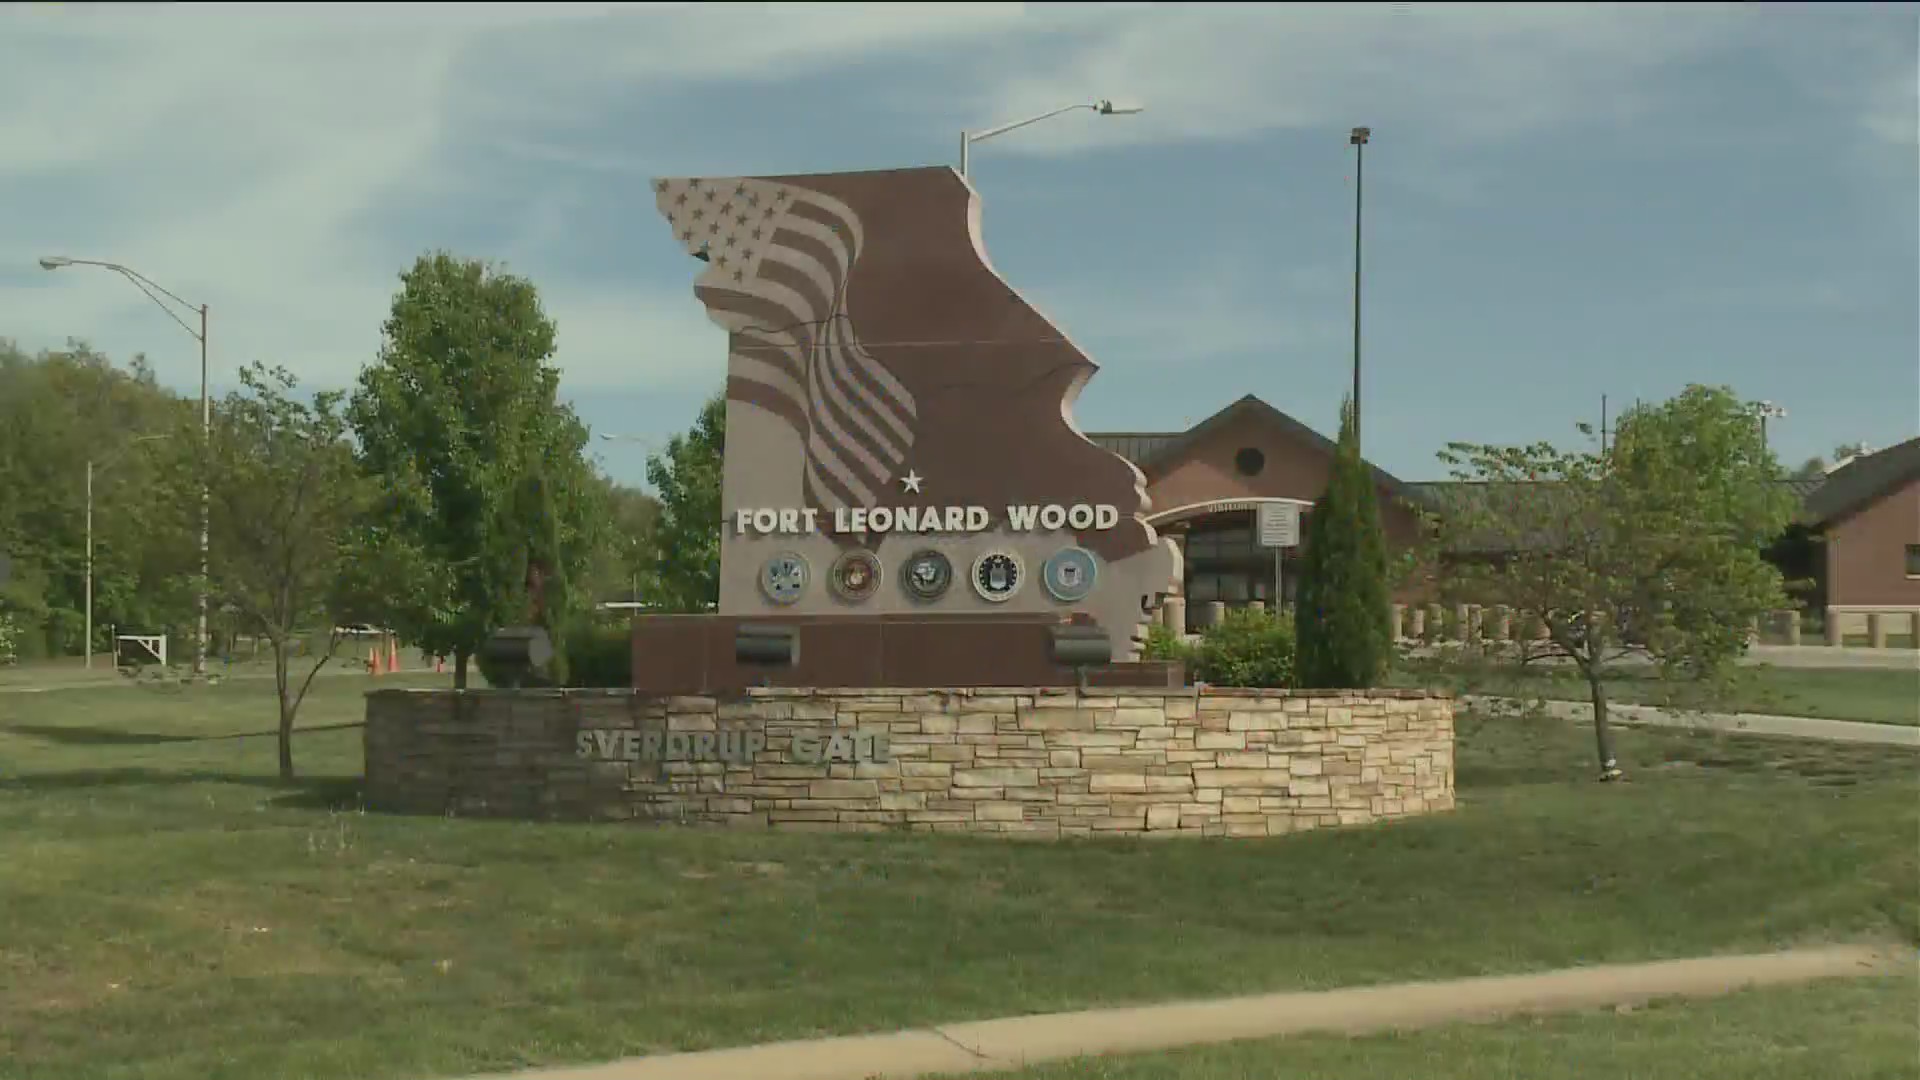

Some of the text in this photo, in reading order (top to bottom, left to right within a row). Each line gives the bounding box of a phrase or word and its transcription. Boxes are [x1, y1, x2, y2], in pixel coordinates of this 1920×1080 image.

[736, 504, 1119, 534] FORT LEONARD WOOD
[576, 728, 890, 763] SVERDRUP GATE
